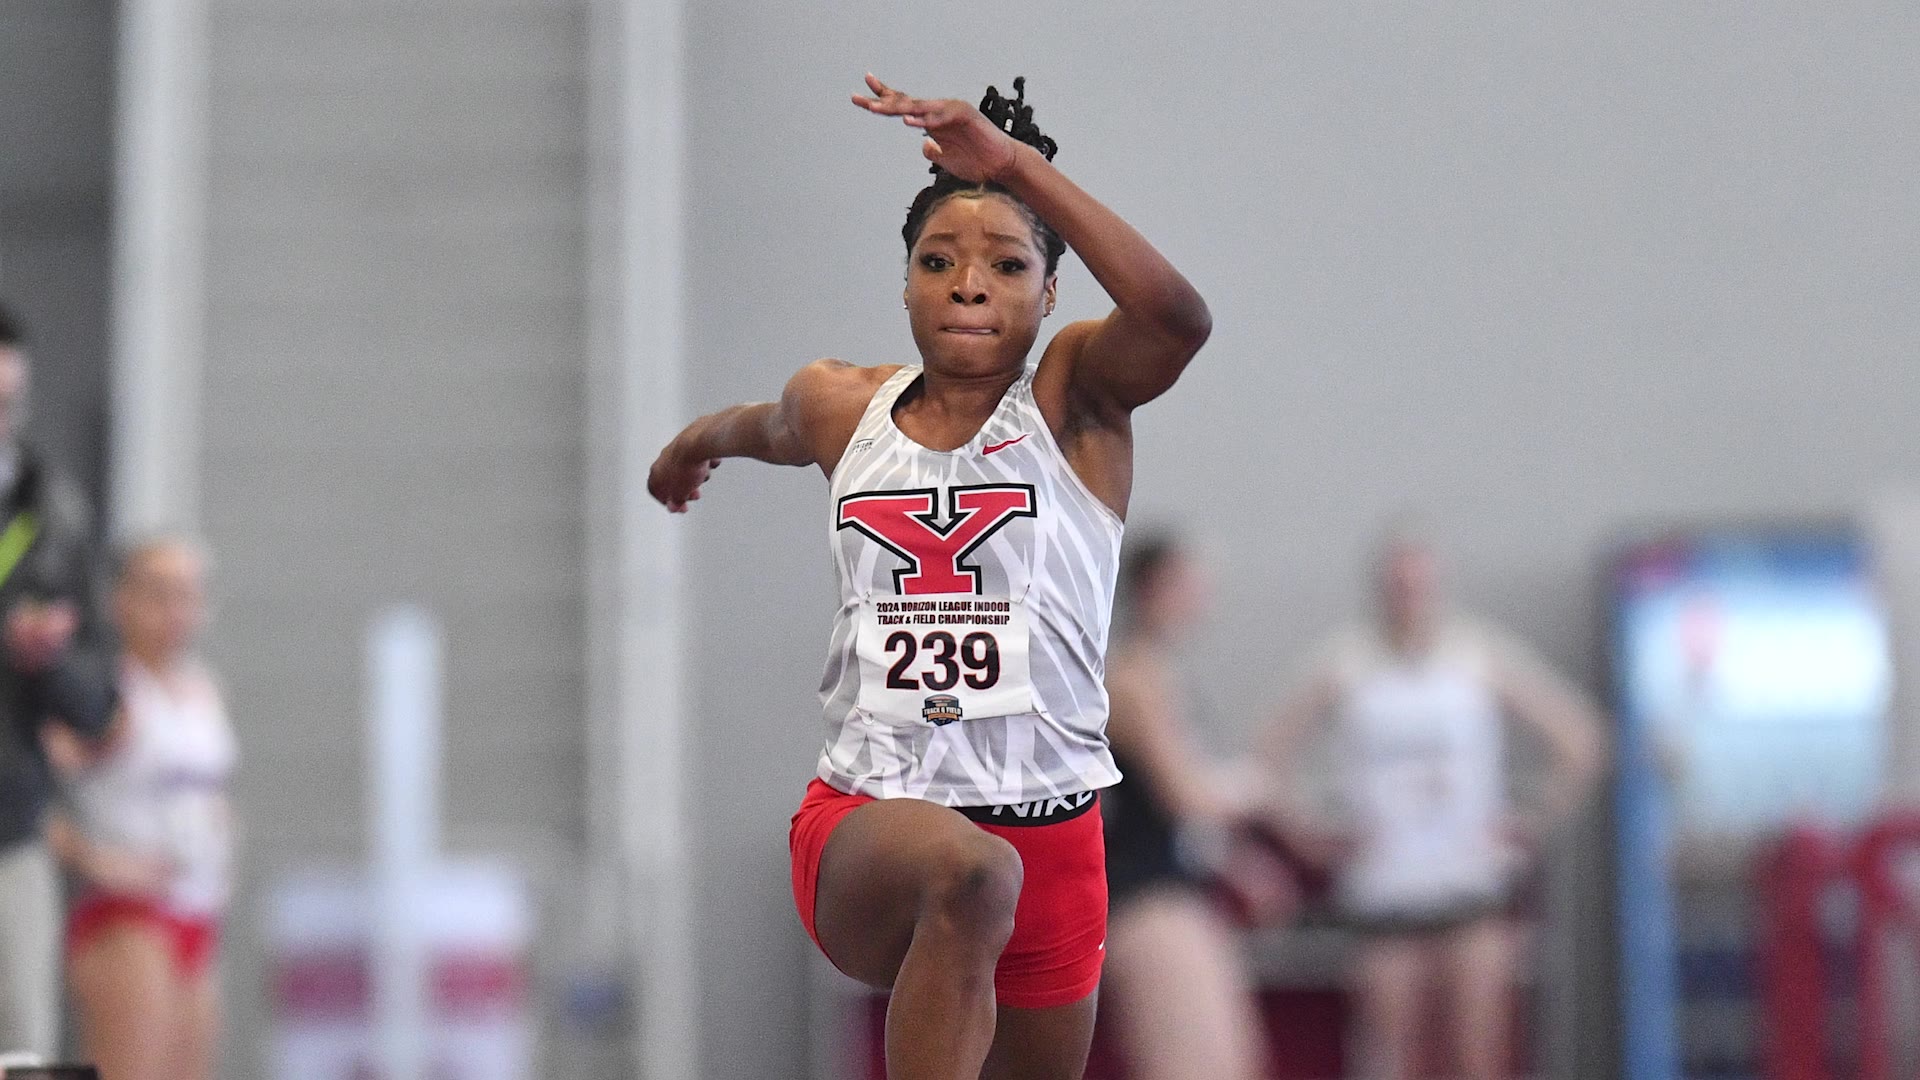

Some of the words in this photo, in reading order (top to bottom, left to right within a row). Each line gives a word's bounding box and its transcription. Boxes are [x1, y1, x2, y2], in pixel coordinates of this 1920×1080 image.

[837, 483, 1037, 595] Y
[876, 602, 900, 612] 2024
[901, 601, 937, 612] HORIZON
[938, 601, 972, 612] LEAGUE
[974, 601, 1010, 612] INDOOR
[877, 615, 905, 625] TRACK
[905, 616, 911, 624] &
[913, 614, 936, 624] FIELD
[938, 614, 1010, 625] CHAMPIONSHIP
[884, 630, 1001, 691] 239
